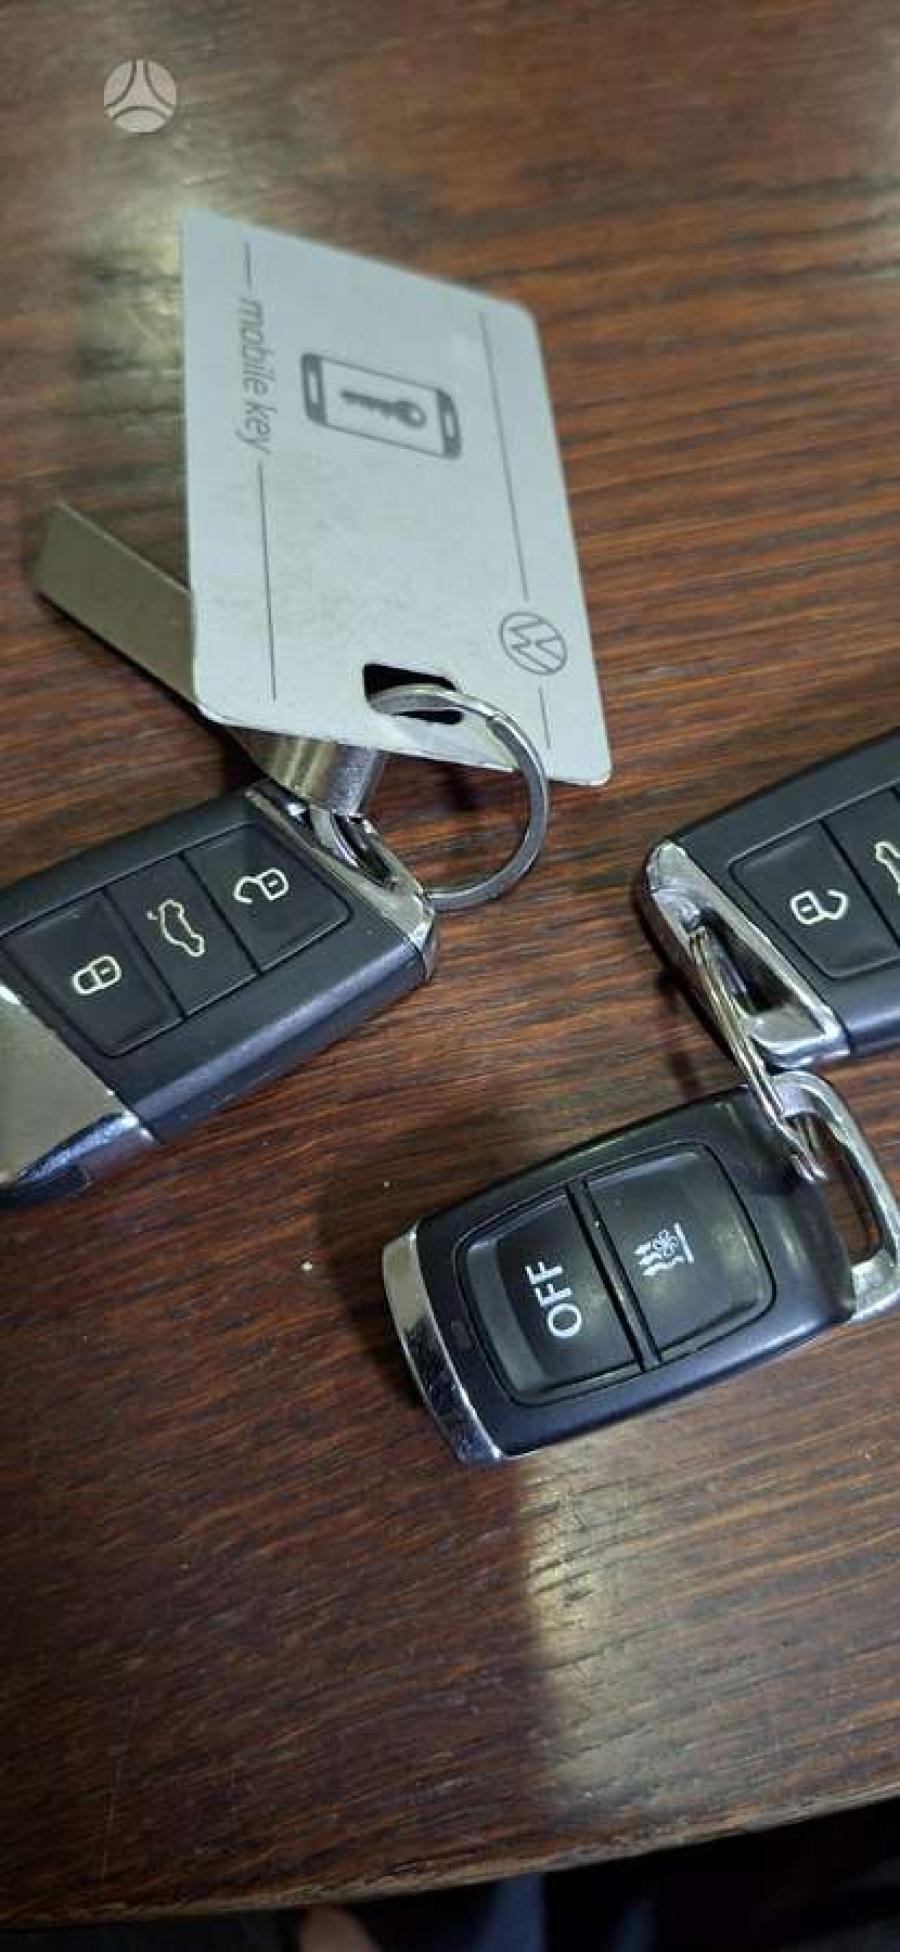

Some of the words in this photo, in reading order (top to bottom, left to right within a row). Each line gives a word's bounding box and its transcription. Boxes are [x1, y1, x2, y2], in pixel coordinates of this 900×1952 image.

[239, 297, 276, 395] mobile
[235, 400, 278, 454] key
[525, 1261, 582, 1338] OFF
